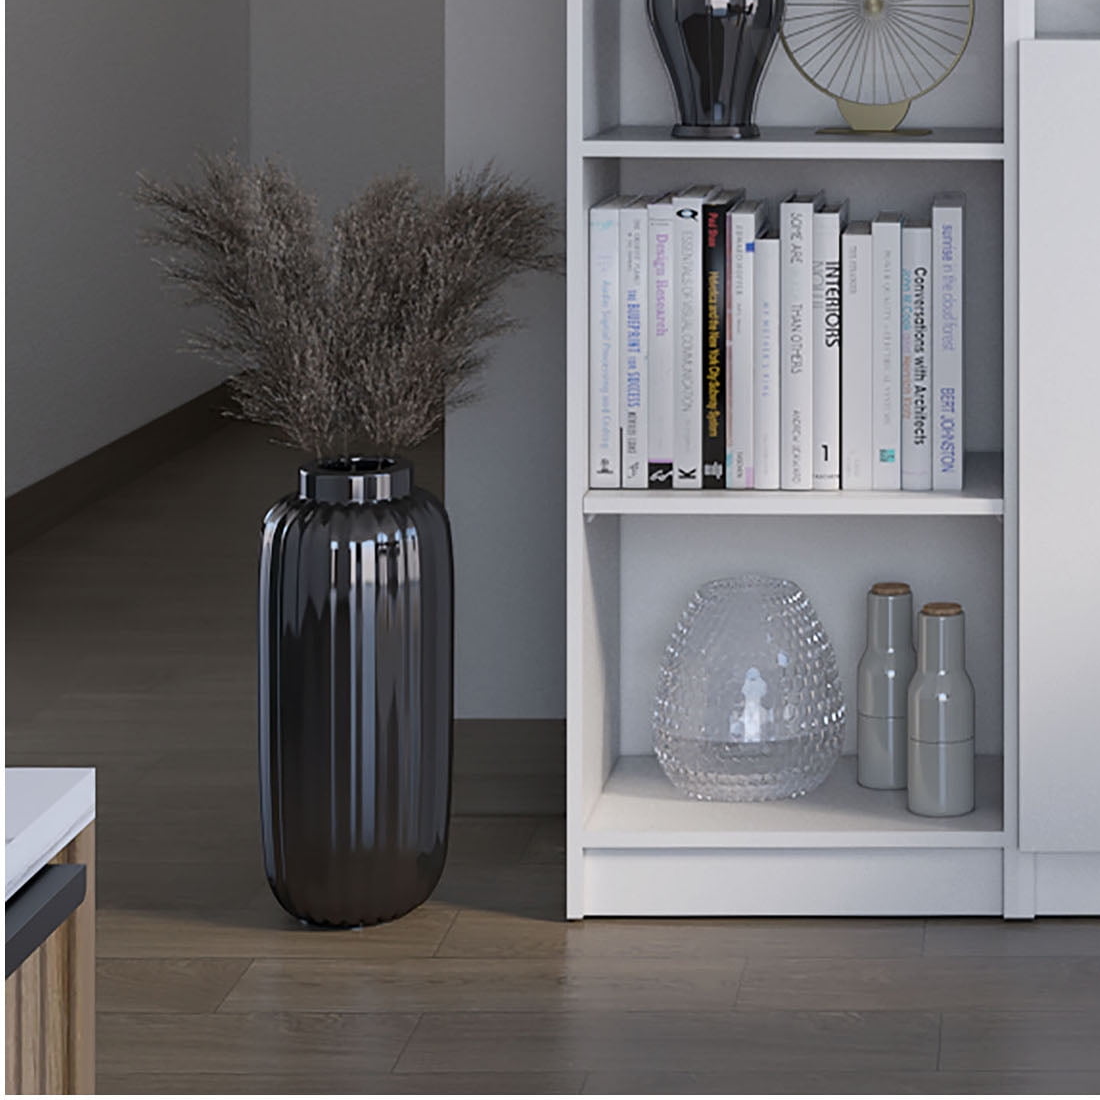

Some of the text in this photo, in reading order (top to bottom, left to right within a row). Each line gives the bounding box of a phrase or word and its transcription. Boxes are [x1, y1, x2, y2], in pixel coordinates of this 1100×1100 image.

[654, 234, 669, 337] Design Research
[681, 230, 694, 288] ESSENTIALS
[791, 213, 803, 374] SOME ARE THAN OTHERS
[940, 224, 954, 351] sunrise in the cloud forest
[627, 304, 640, 353] BLUEPRINT
[708, 332, 719, 348] New
[826, 261, 840, 348] INTERIORS
[627, 372, 640, 408] SUCCESS
[681, 335, 694, 412] COMMUNICATION
[708, 350, 719, 366] York
[914, 267, 927, 445] Conversations with Architects
[940, 388, 955, 473] BERT JOHNSTON
